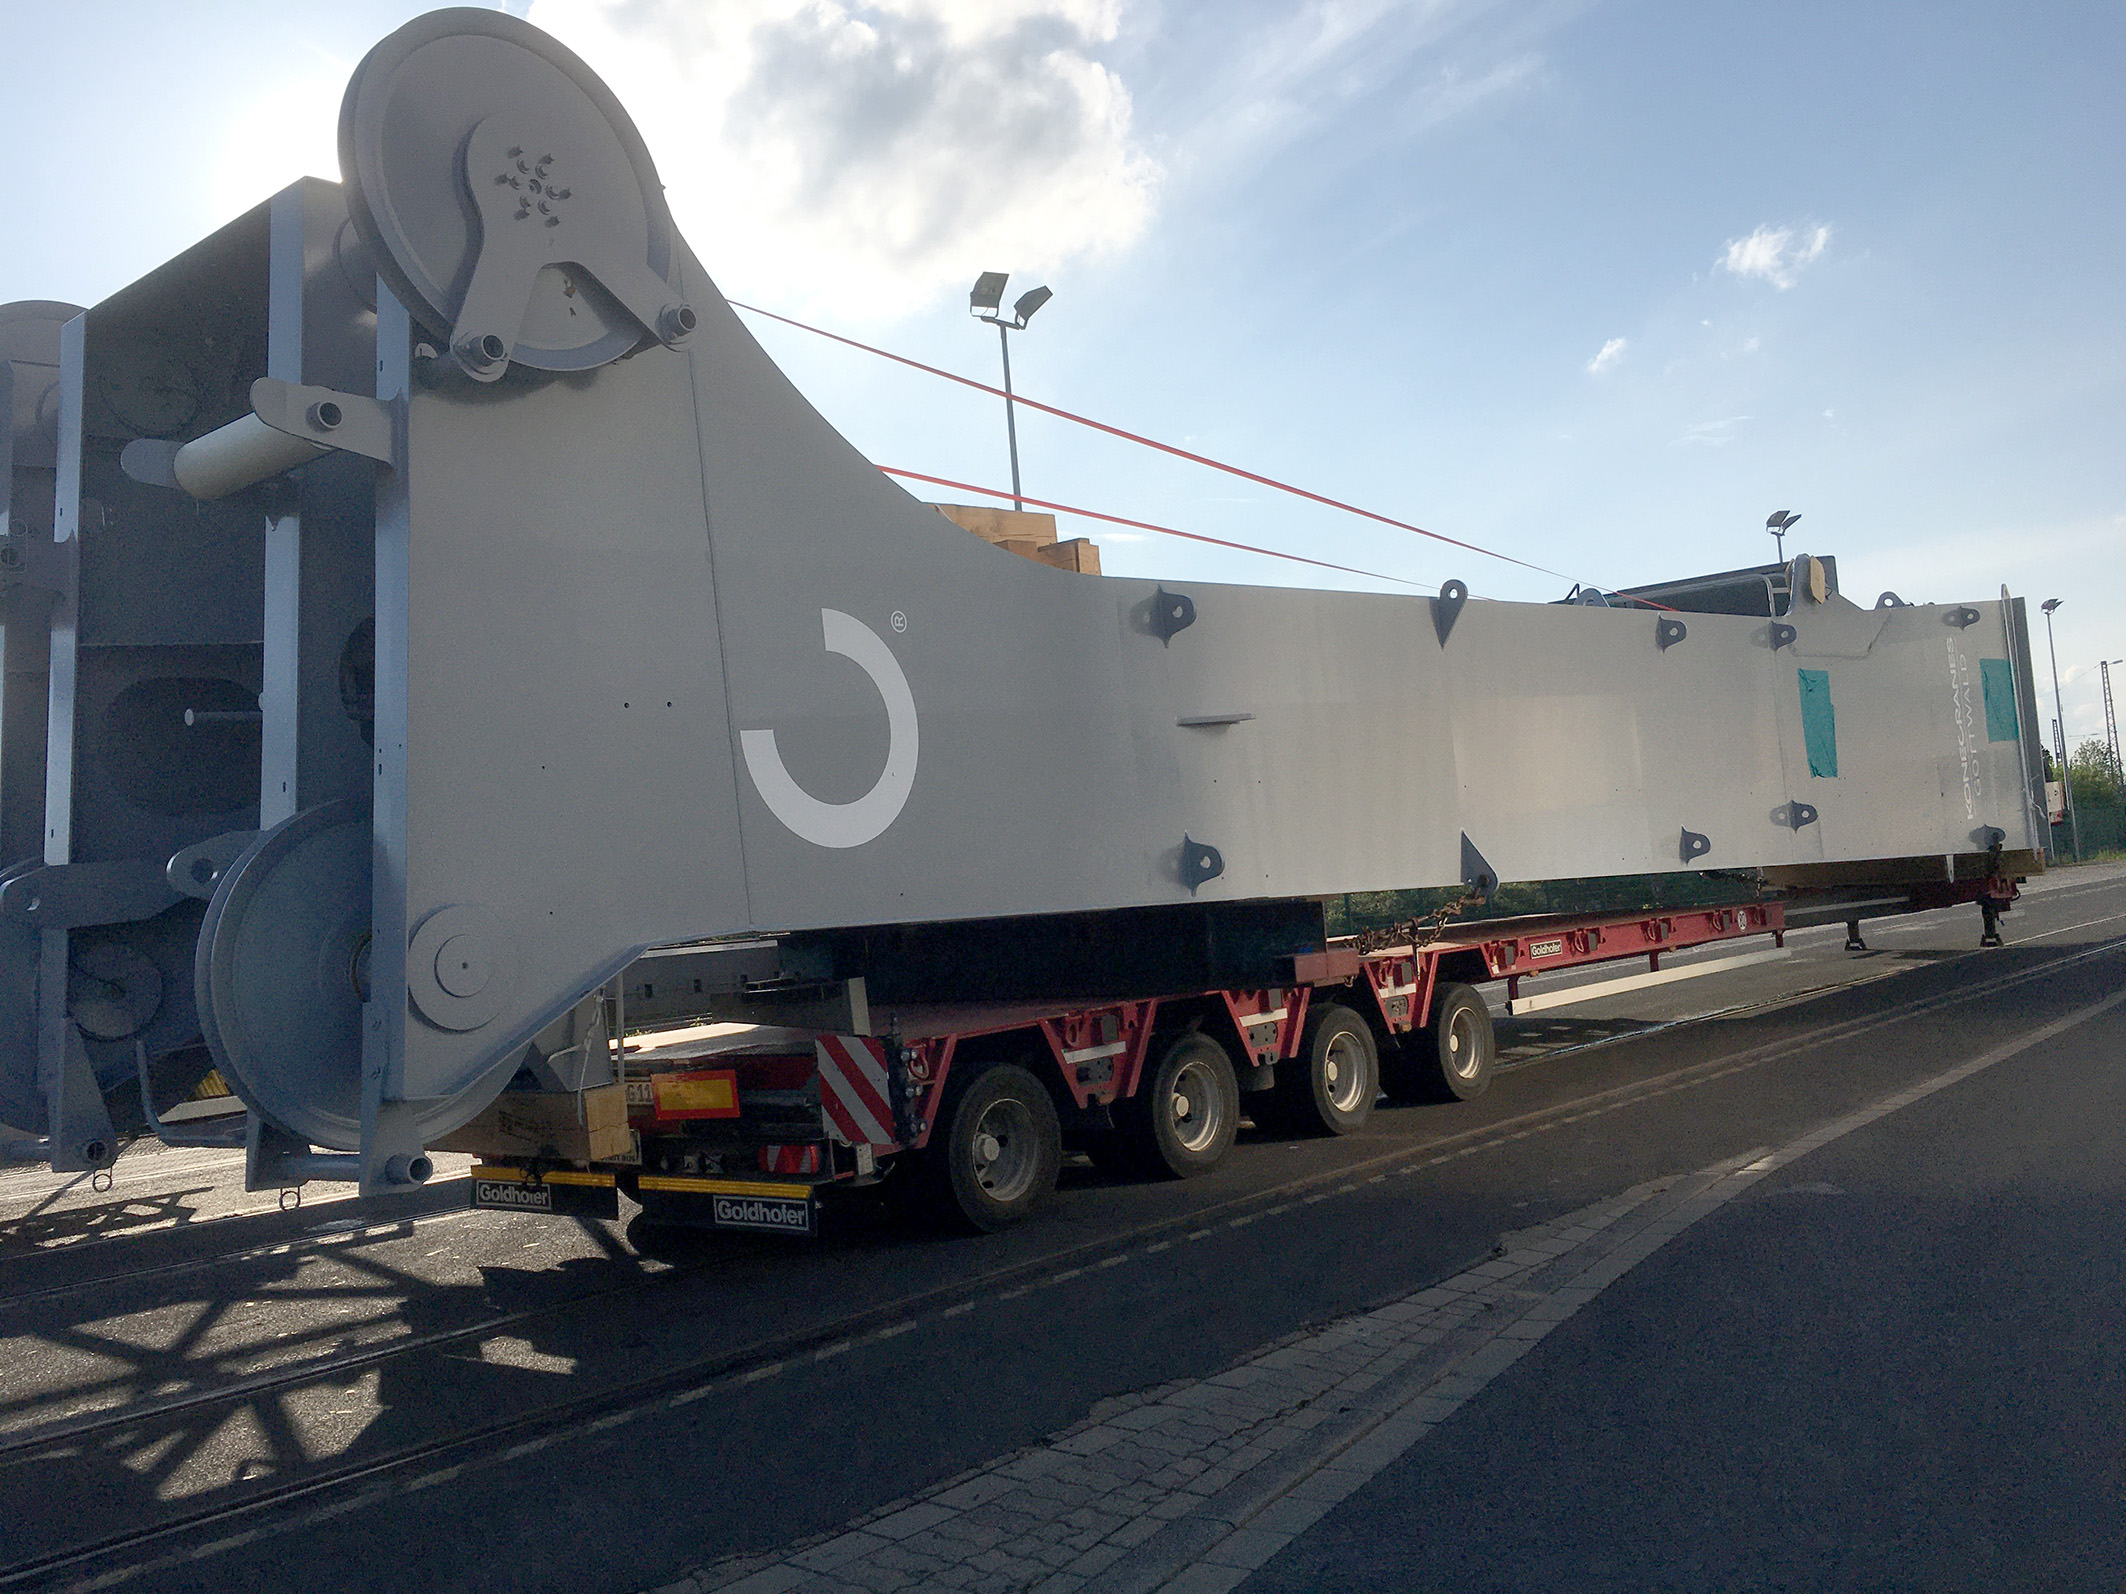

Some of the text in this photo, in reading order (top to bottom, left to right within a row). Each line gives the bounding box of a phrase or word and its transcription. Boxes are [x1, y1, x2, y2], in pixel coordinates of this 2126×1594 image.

[1946, 637, 1974, 820] KONECRANES
[1960, 654, 1982, 797] GOTTWALD
[1532, 942, 1561, 956] Goldhofer
[718, 1200, 804, 1225] Goldhofer
